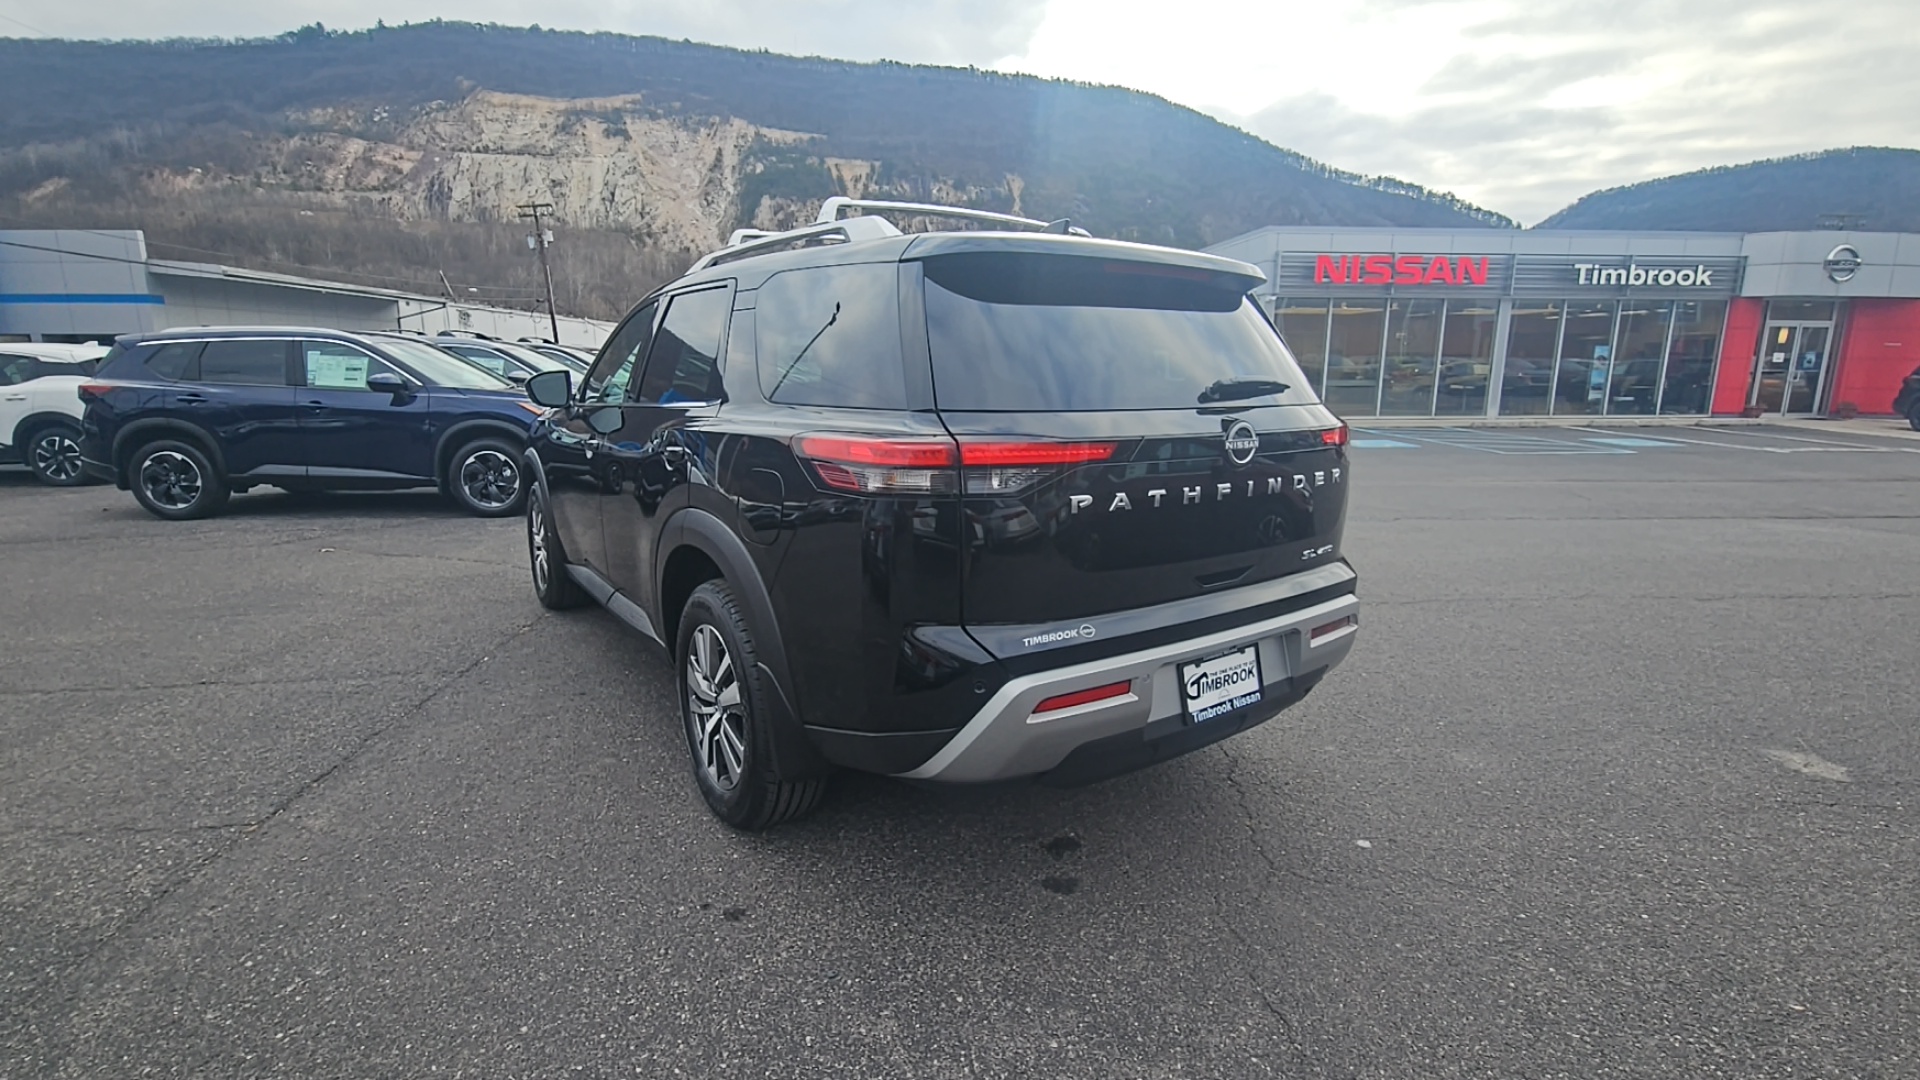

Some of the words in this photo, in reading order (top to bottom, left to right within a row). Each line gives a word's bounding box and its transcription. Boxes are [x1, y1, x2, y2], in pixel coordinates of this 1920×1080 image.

[1314, 254, 1489, 285] NISSAN
[1574, 263, 1713, 286] Timbrook
[1225, 437, 1259, 450] NISSAN
[1070, 468, 1341, 514] PATHFINDER
[1022, 629, 1078, 647] TIMBROOK
[1187, 666, 1256, 700] TIMBROOK
[1192, 701, 1233, 723] Timbrook
[1233, 692, 1261, 709] Nissan
